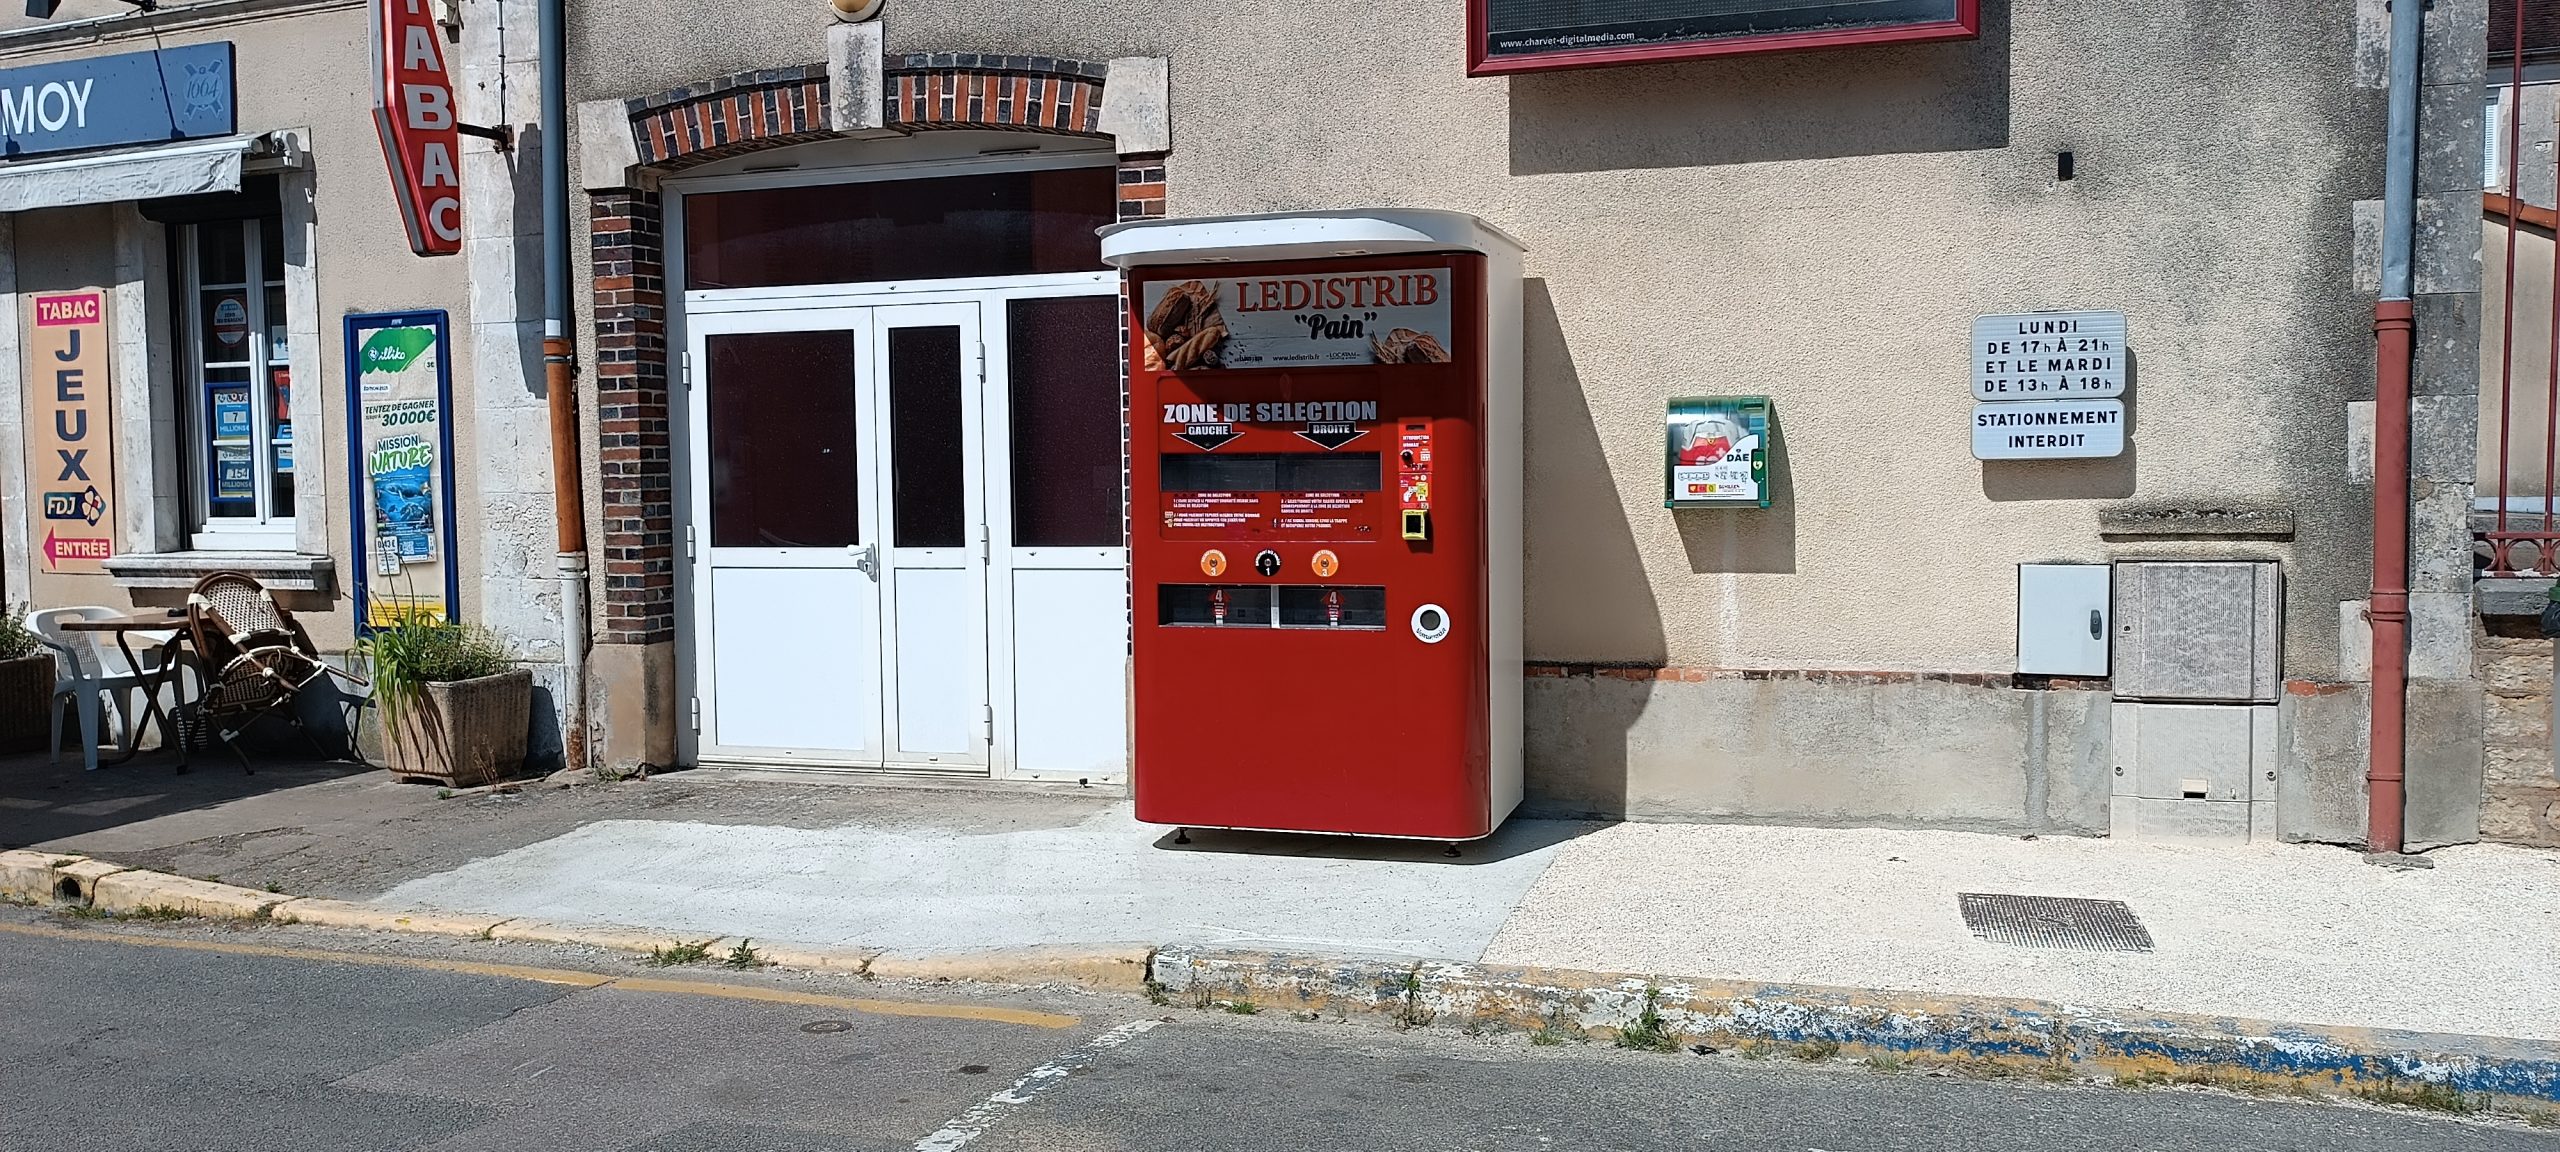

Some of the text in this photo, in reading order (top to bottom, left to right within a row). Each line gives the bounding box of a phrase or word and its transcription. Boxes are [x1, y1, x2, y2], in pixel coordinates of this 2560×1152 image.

[1500, 32, 1634, 48] www.charvet-digitalmedia.com
[1, 78, 94, 136] MOY
[1236, 274, 1438, 312] LEDISTRIB
[40, 300, 96, 320] TABAC
[2019, 320, 2077, 334] LUNDI
[1988, 337, 2109, 354] DE 17h À 21h
[378, 346, 405, 360] illiko
[1273, 354, 1320, 362] www.ledistrib.fr
[1986, 358, 2111, 373] ET LE MARDI
[1985, 375, 2112, 392] DE 13h À 18h
[55, 329, 91, 481] JEUX
[365, 400, 434, 414] TENTEZ DE GAGNER
[1164, 401, 1377, 423] ZONE DE SELECTION
[233, 412, 238, 422] 7
[1977, 411, 2117, 426] STATIONNEMENT
[1188, 426, 1228, 435] GAUCHE
[1312, 424, 1350, 434] DROITE
[378, 436, 418, 451] MISSION
[2009, 434, 2085, 448] INTERDIT
[371, 445, 432, 474] NATURE
[1727, 454, 1749, 462] DAE
[47, 497, 76, 515] FDJ
[55, 540, 108, 556] ENTRÉE
[1210, 568, 1216, 576] 3
[1266, 568, 1270, 576] 1
[1322, 568, 1328, 576] 3
[1215, 590, 1222, 602] 4
[1330, 592, 1337, 604] 4
